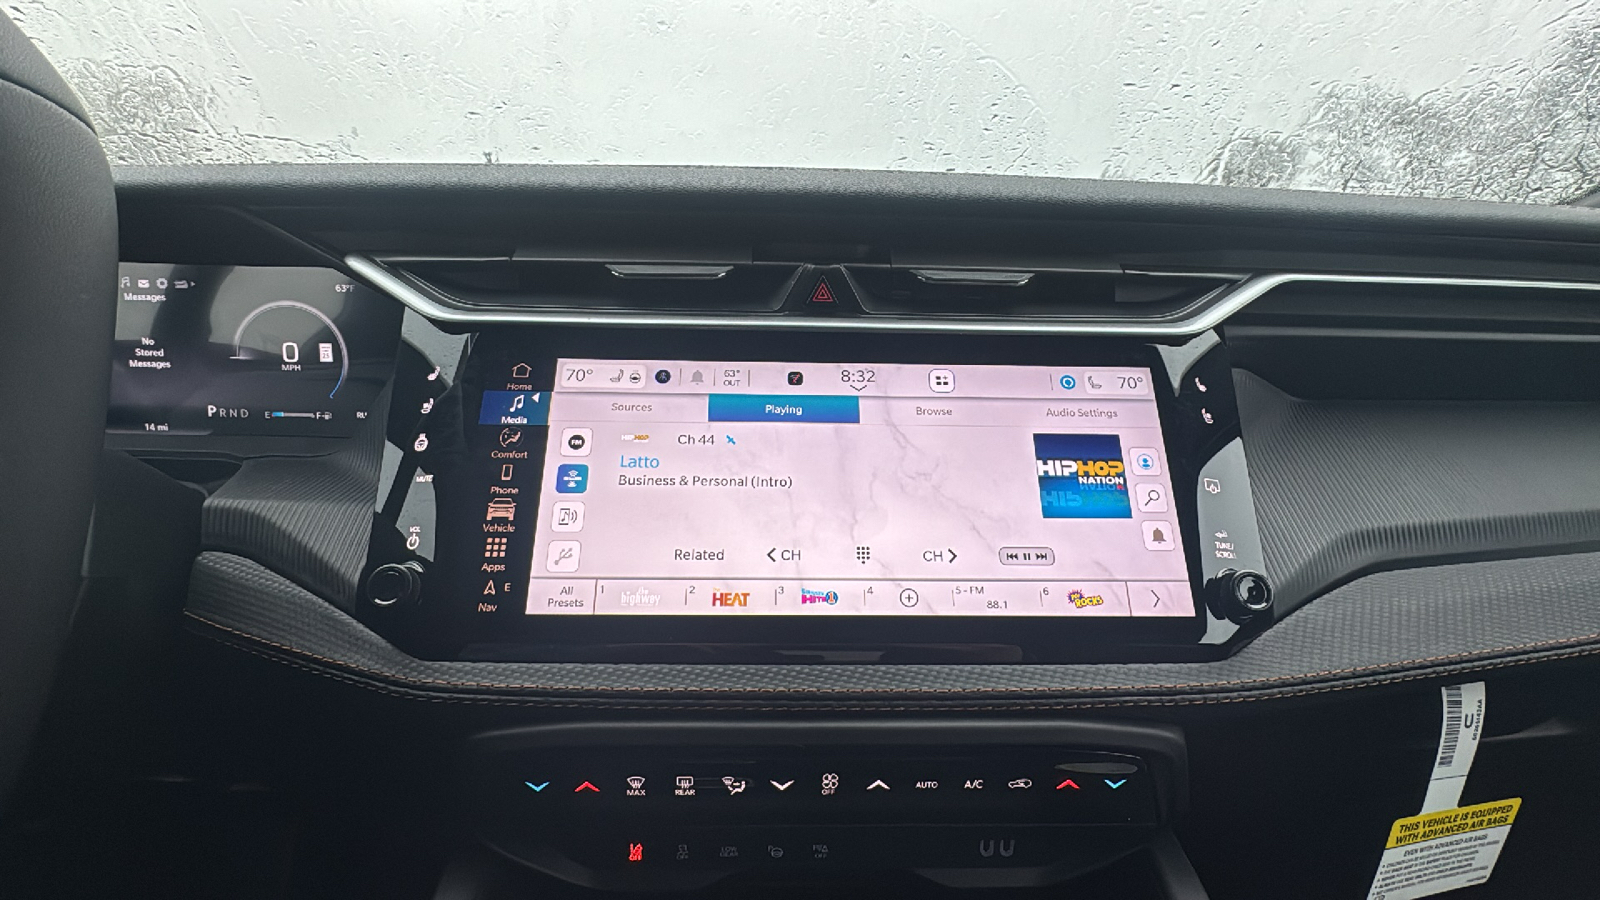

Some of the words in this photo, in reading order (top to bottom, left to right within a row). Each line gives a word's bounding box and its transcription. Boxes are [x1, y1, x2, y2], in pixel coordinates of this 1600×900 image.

[124, 293, 166, 302] Messages
[141, 337, 155, 346] No
[135, 348, 164, 357] Stored
[282, 342, 299, 362] 0
[129, 360, 171, 369] Messages
[282, 364, 301, 372] MPH
[566, 368, 594, 382] 70°
[841, 370, 876, 383] 8:32
[506, 383, 533, 391] Home
[723, 379, 740, 387] OUT
[1117, 376, 1143, 389] 70°
[611, 403, 653, 412] Sources
[765, 404, 803, 416] Playing
[916, 406, 953, 416] Browse
[1046, 408, 1076, 417] Audio
[1077, 408, 1118, 419] Settings
[501, 416, 528, 424] Media
[144, 423, 154, 431] 14
[157, 423, 168, 431] mi
[677, 434, 696, 445] Ch
[698, 435, 715, 445] 44
[491, 450, 528, 459] Comfort
[620, 454, 660, 468] Latto
[416, 474, 434, 483] MUTE
[618, 475, 676, 486] Business
[679, 476, 689, 486] &
[692, 475, 748, 487] Personal
[751, 475, 793, 488] (Intro)
[1078, 476, 1124, 484] NATION
[490, 486, 519, 495] Phone
[483, 524, 516, 532] Vehicle
[674, 549, 725, 561] Related
[781, 550, 801, 561] CH
[923, 551, 944, 562] CH
[481, 563, 506, 573] Apps
[504, 583, 511, 592] E
[559, 586, 574, 595] All
[600, 584, 604, 594] 1
[689, 585, 696, 594] 2
[778, 586, 785, 594] 3
[867, 587, 874, 595] 4
[1042, 588, 1049, 596] 6
[547, 598, 584, 608] Presets
[712, 592, 750, 607] HEAT
[1075, 595, 1104, 608] ROCKS
[478, 603, 498, 613] Nav
[986, 601, 1008, 609] 88.1
[915, 781, 938, 789] AUTO
[964, 780, 984, 789] A/C
[1400, 822, 1420, 834] THIS
[1423, 813, 1460, 829] VEHICLE
[1460, 811, 1469, 821] IS
[1471, 805, 1513, 819] EQUIPPED
[1396, 832, 1421, 845] WITH
[1420, 822, 1469, 839] ADVANCED
[1470, 819, 1485, 829] AIR
[1486, 815, 1510, 827] BAGS
